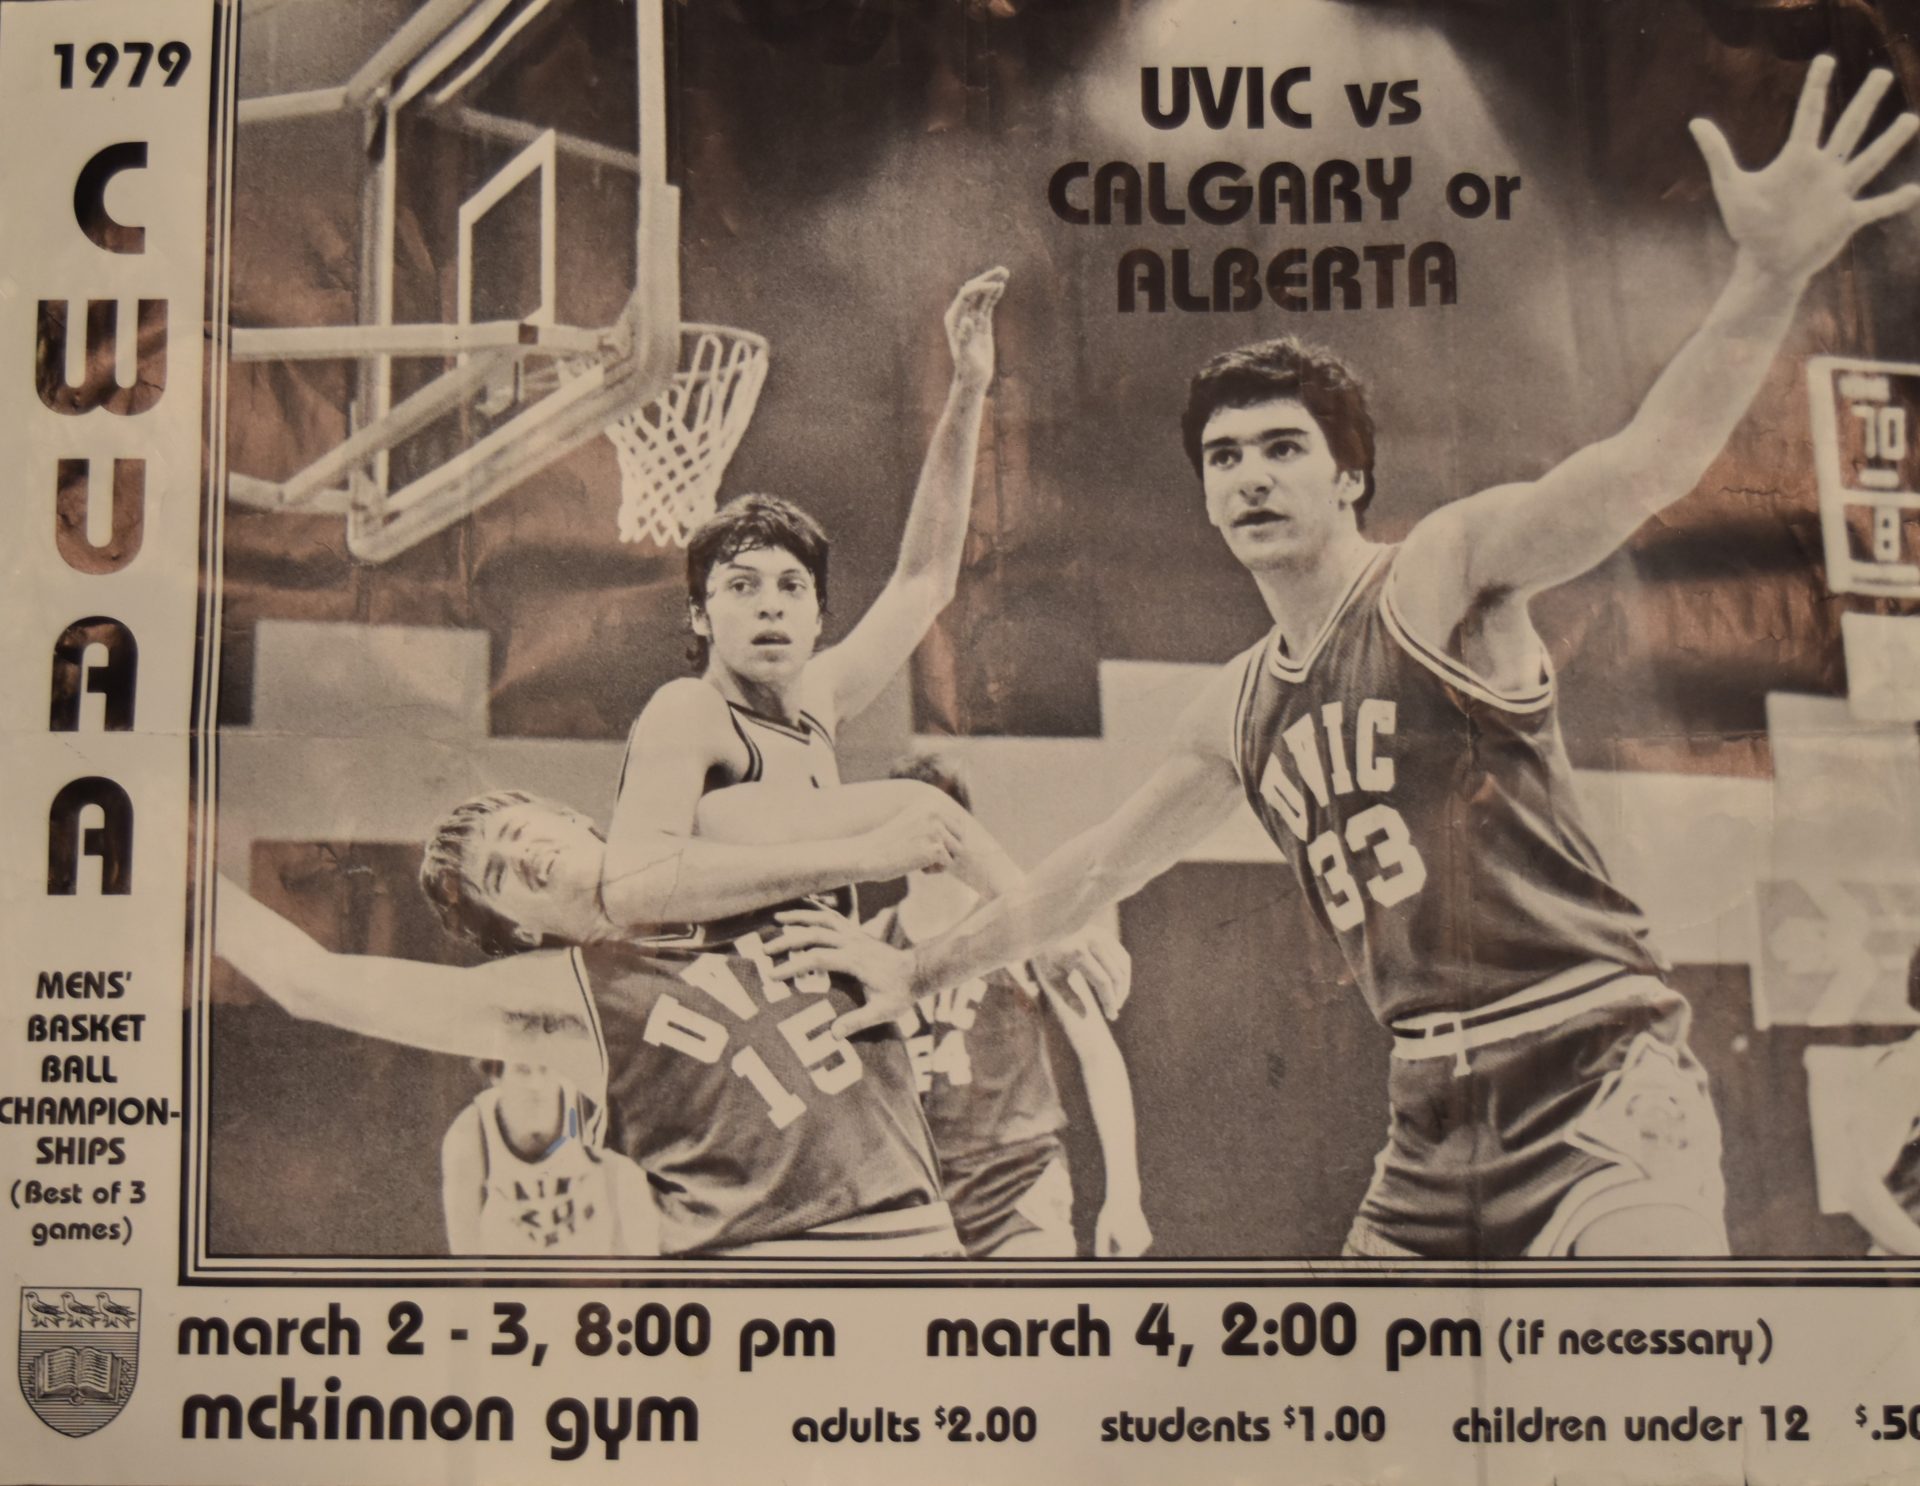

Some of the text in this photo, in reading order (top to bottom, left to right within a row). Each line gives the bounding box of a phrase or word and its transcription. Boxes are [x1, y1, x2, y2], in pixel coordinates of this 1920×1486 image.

[54, 41, 191, 89] 1979
[1141, 67, 1421, 130] UVIC vs
[1047, 156, 1521, 226] CALGARY or
[1117, 241, 1457, 313] ALBERTA
[1259, 699, 1396, 843] UVIC
[1307, 804, 1427, 932] 33
[36, 972, 131, 999] MENS'
[643, 931, 831, 1064] UVI
[28, 1015, 145, 1042] BASKET
[42, 1055, 117, 1083] BALL
[731, 999, 863, 1131] 15
[0, 1097, 180, 1125] CHAMPION-
[36, 1137, 125, 1165] SHIPS
[11, 1180, 146, 1209] (Best of 3
[32, 1216, 132, 1246] games)
[178, 1303, 360, 1355] march
[387, 1301, 423, 1355] 2
[492, 1303, 547, 1366] 3,
[576, 1302, 710, 1356] 8:00
[740, 1319, 835, 1372] pm
[927, 1304, 1110, 1357] march
[1135, 1303, 1193, 1367] 4,
[1222, 1302, 1356, 1356] 2:00
[1386, 1318, 1481, 1371] pm
[1499, 1318, 1544, 1363] (if
[1559, 1318, 1772, 1365] necessary)
[182, 1376, 698, 1461] mckinnon gym
[792, 1407, 920, 1443] adults
[935, 1406, 1036, 1442] $2.00
[1102, 1407, 1270, 1442] students
[1284, 1405, 1386, 1442] $1.00
[1453, 1407, 1606, 1443] children
[1625, 1406, 1742, 1441] under
[1761, 1405, 1809, 1441] 12
